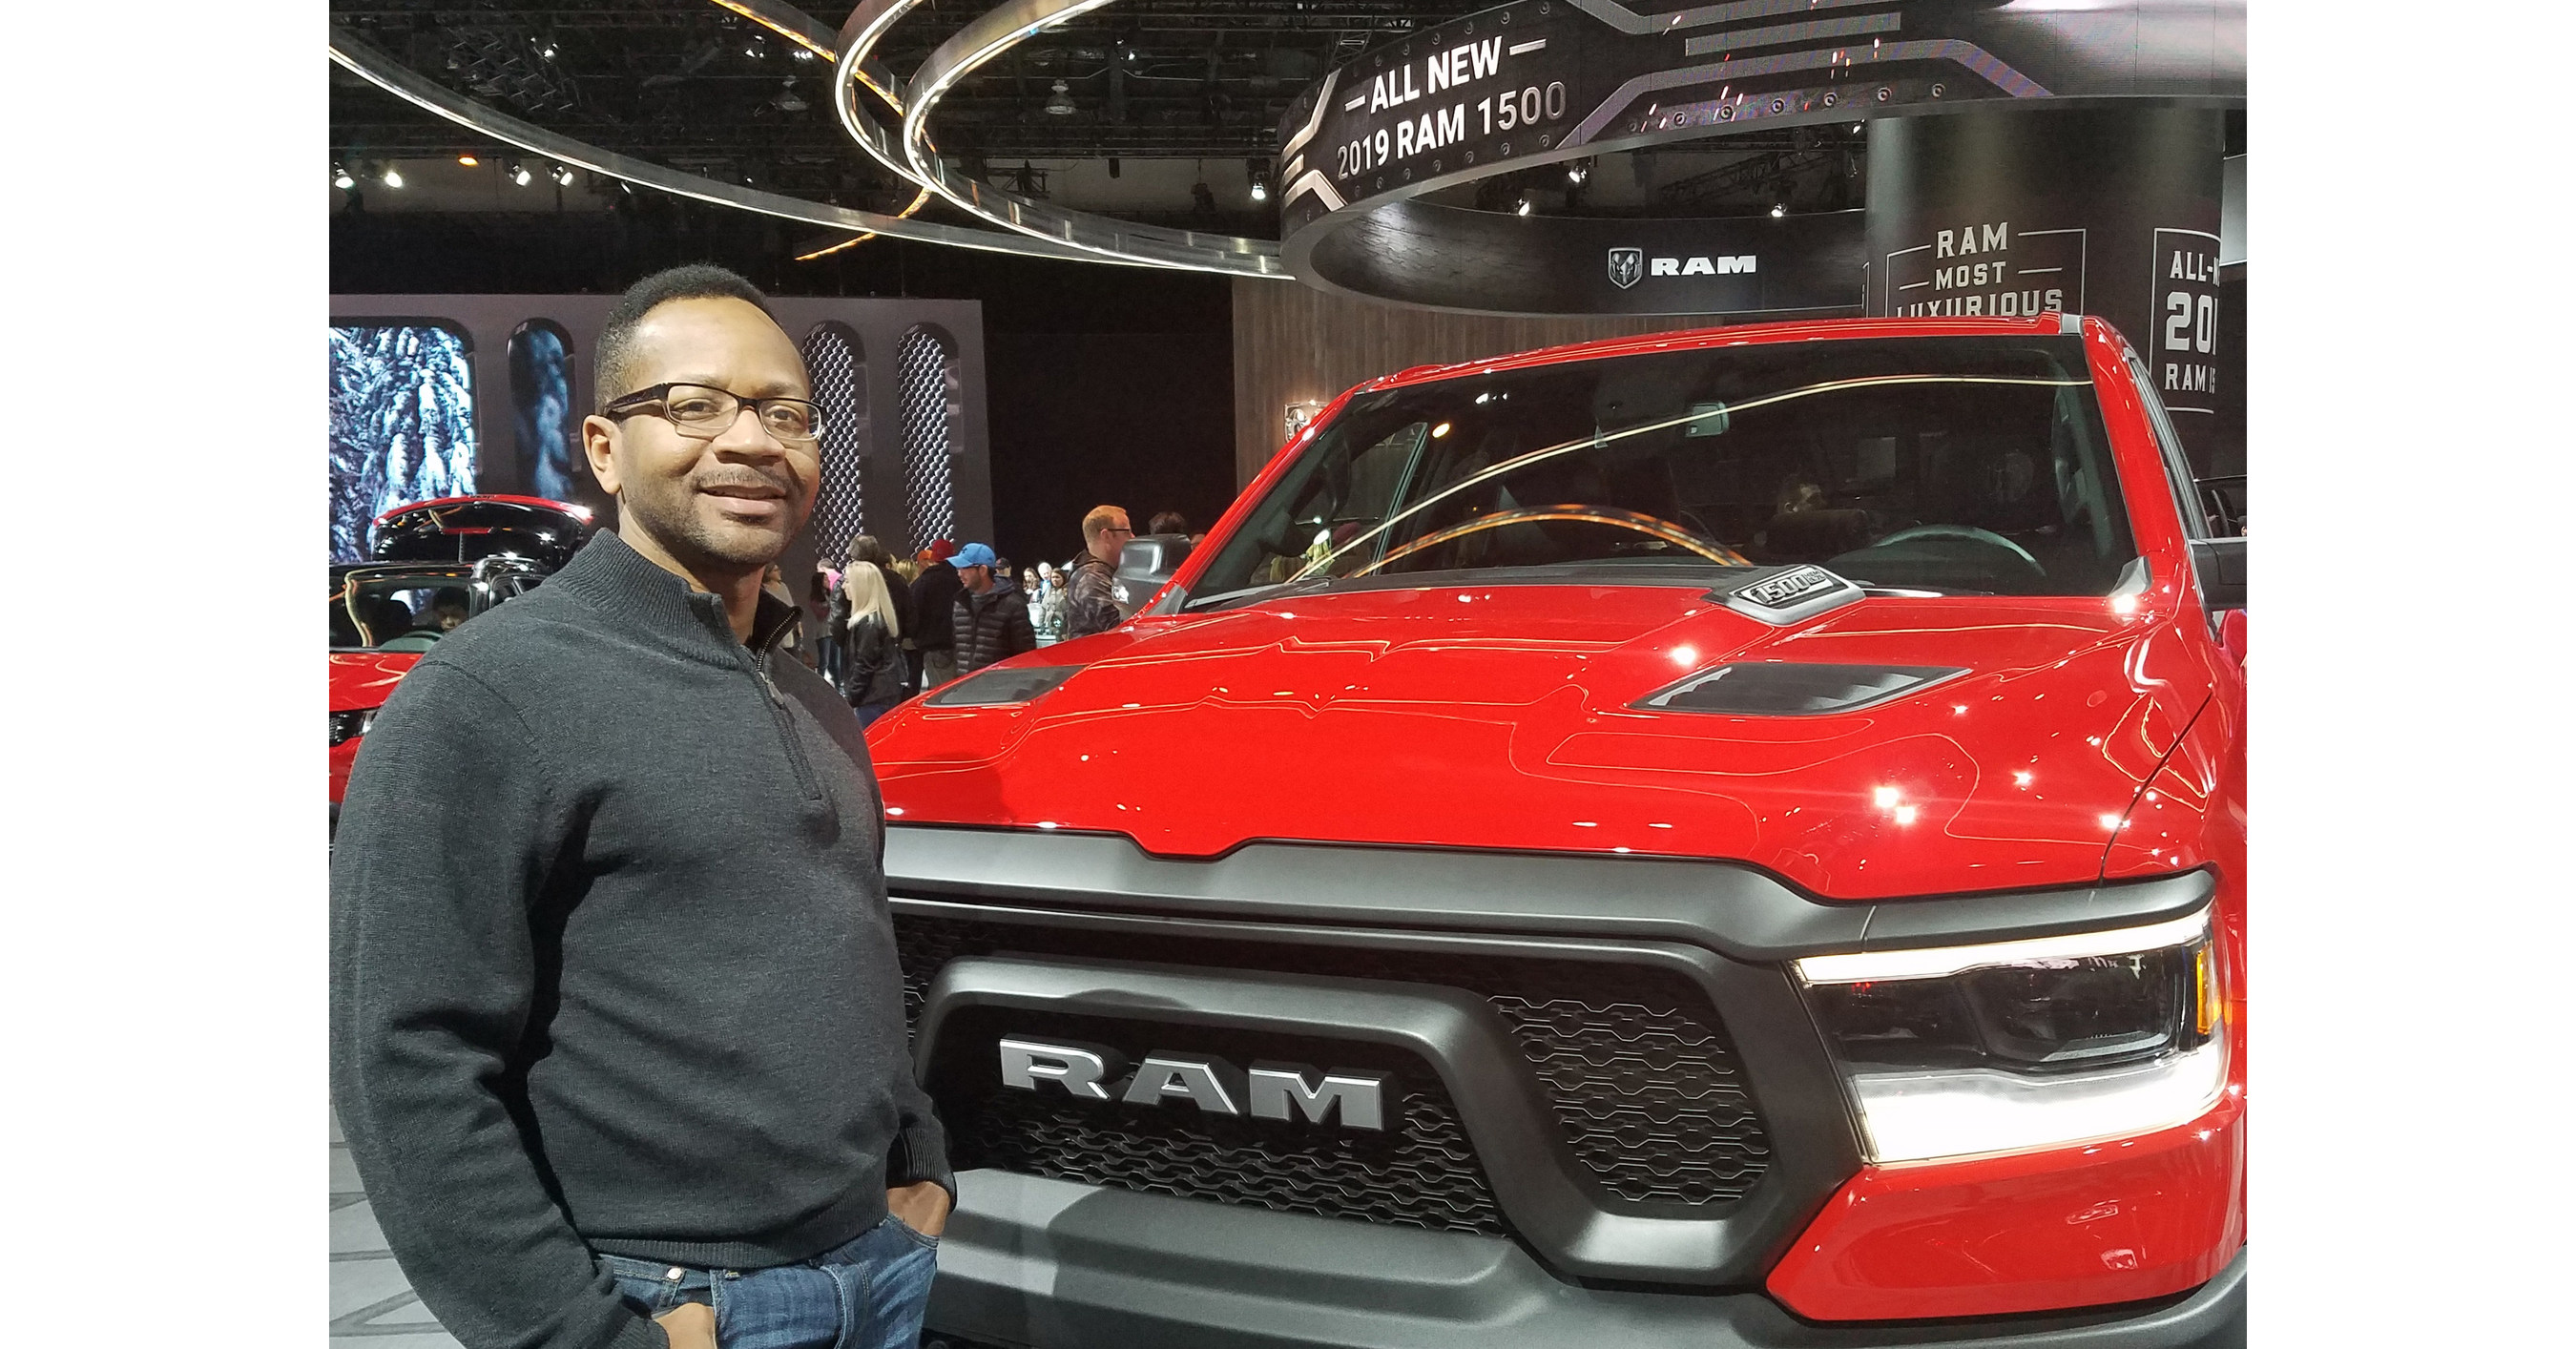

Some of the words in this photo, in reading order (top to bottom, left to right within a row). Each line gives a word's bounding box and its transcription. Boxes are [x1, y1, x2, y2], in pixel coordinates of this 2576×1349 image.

[1370, 63, 1421, 114] ALL
[1427, 35, 1503, 94] NEW
[1337, 128, 1390, 180] 2019
[1397, 103, 1465, 159] RAM
[1478, 81, 1568, 135] 1500
[1936, 221, 2008, 259] RAM
[1651, 255, 1756, 277] RAM
[1935, 260, 2006, 291] MOST
[2164, 363, 2206, 391] RAM
[1752, 574, 1810, 603] 1500
[999, 1036, 1385, 1131] RAM
